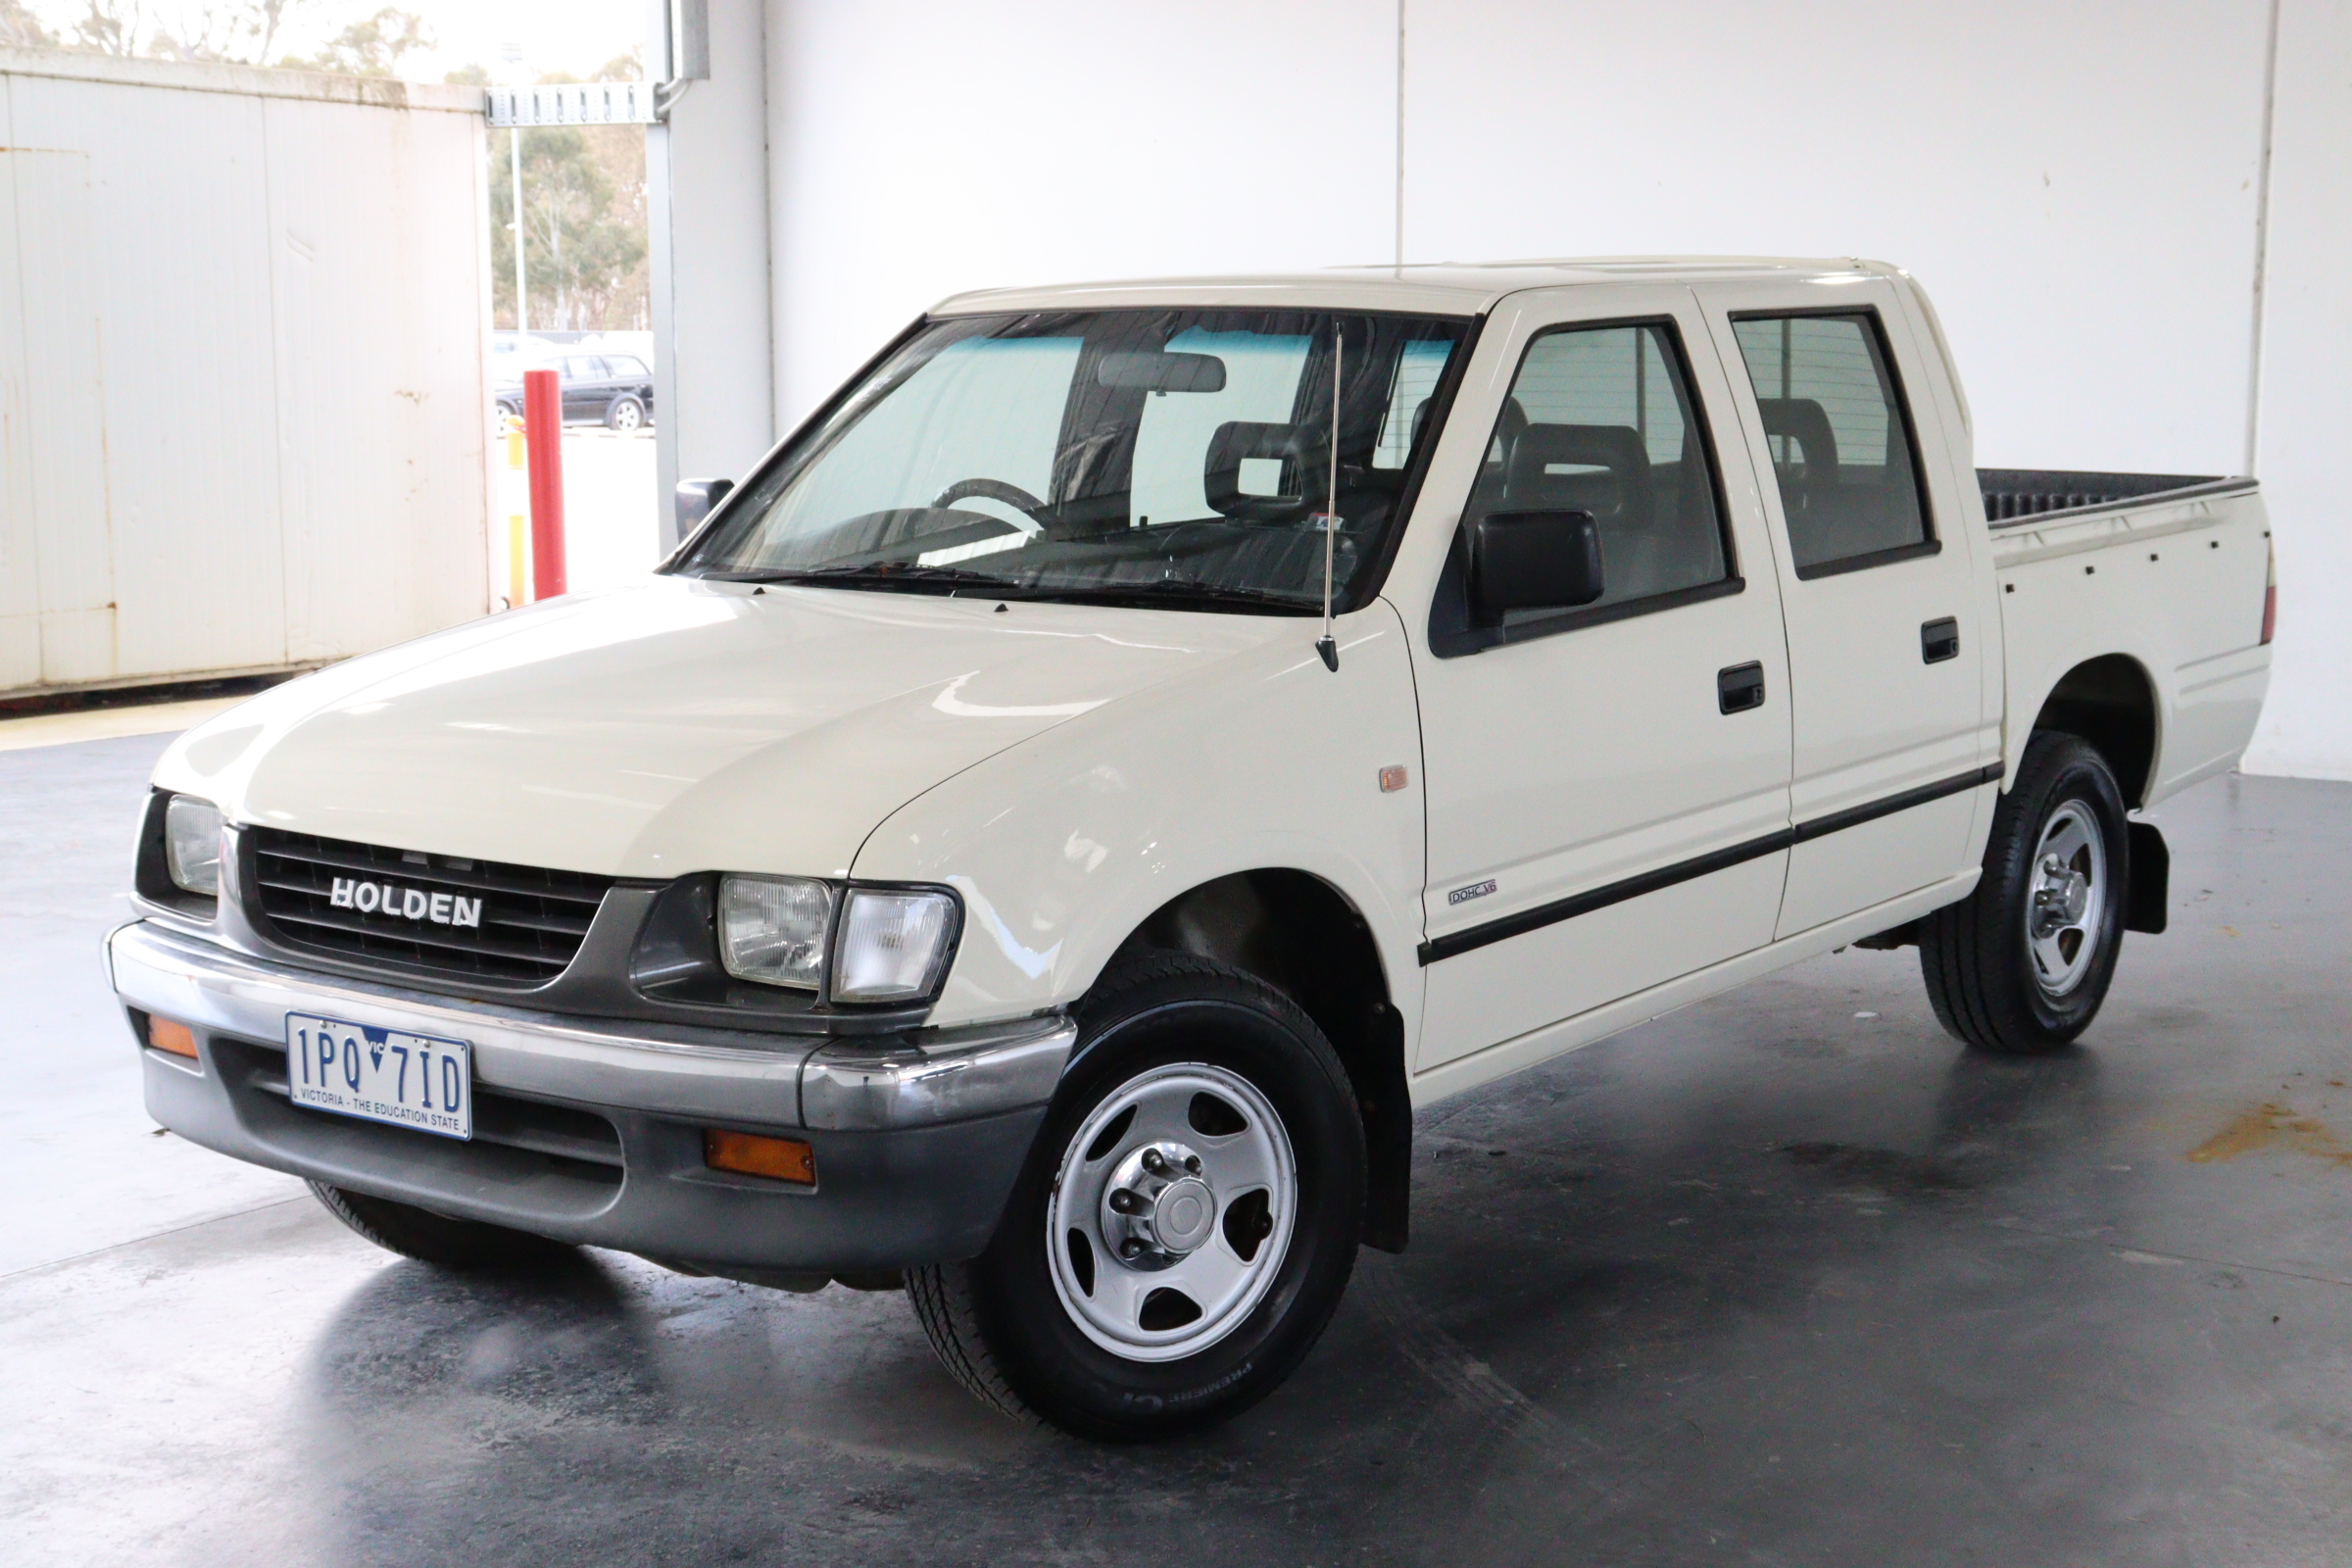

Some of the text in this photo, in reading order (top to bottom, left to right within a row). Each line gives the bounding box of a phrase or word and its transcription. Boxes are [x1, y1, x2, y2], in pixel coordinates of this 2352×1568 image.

[330, 877, 482, 927] HOLDEN
[1452, 882, 1496, 903] DOHC V6
[367, 1041, 385, 1054] VIC
[298, 1027, 460, 1112] 1PQ 7ID
[301, 1088, 344, 1106] VICTORIA
[353, 1099, 371, 1112] THE
[374, 1102, 428, 1124] EDUCATION
[431, 1114, 459, 1131] STATE
